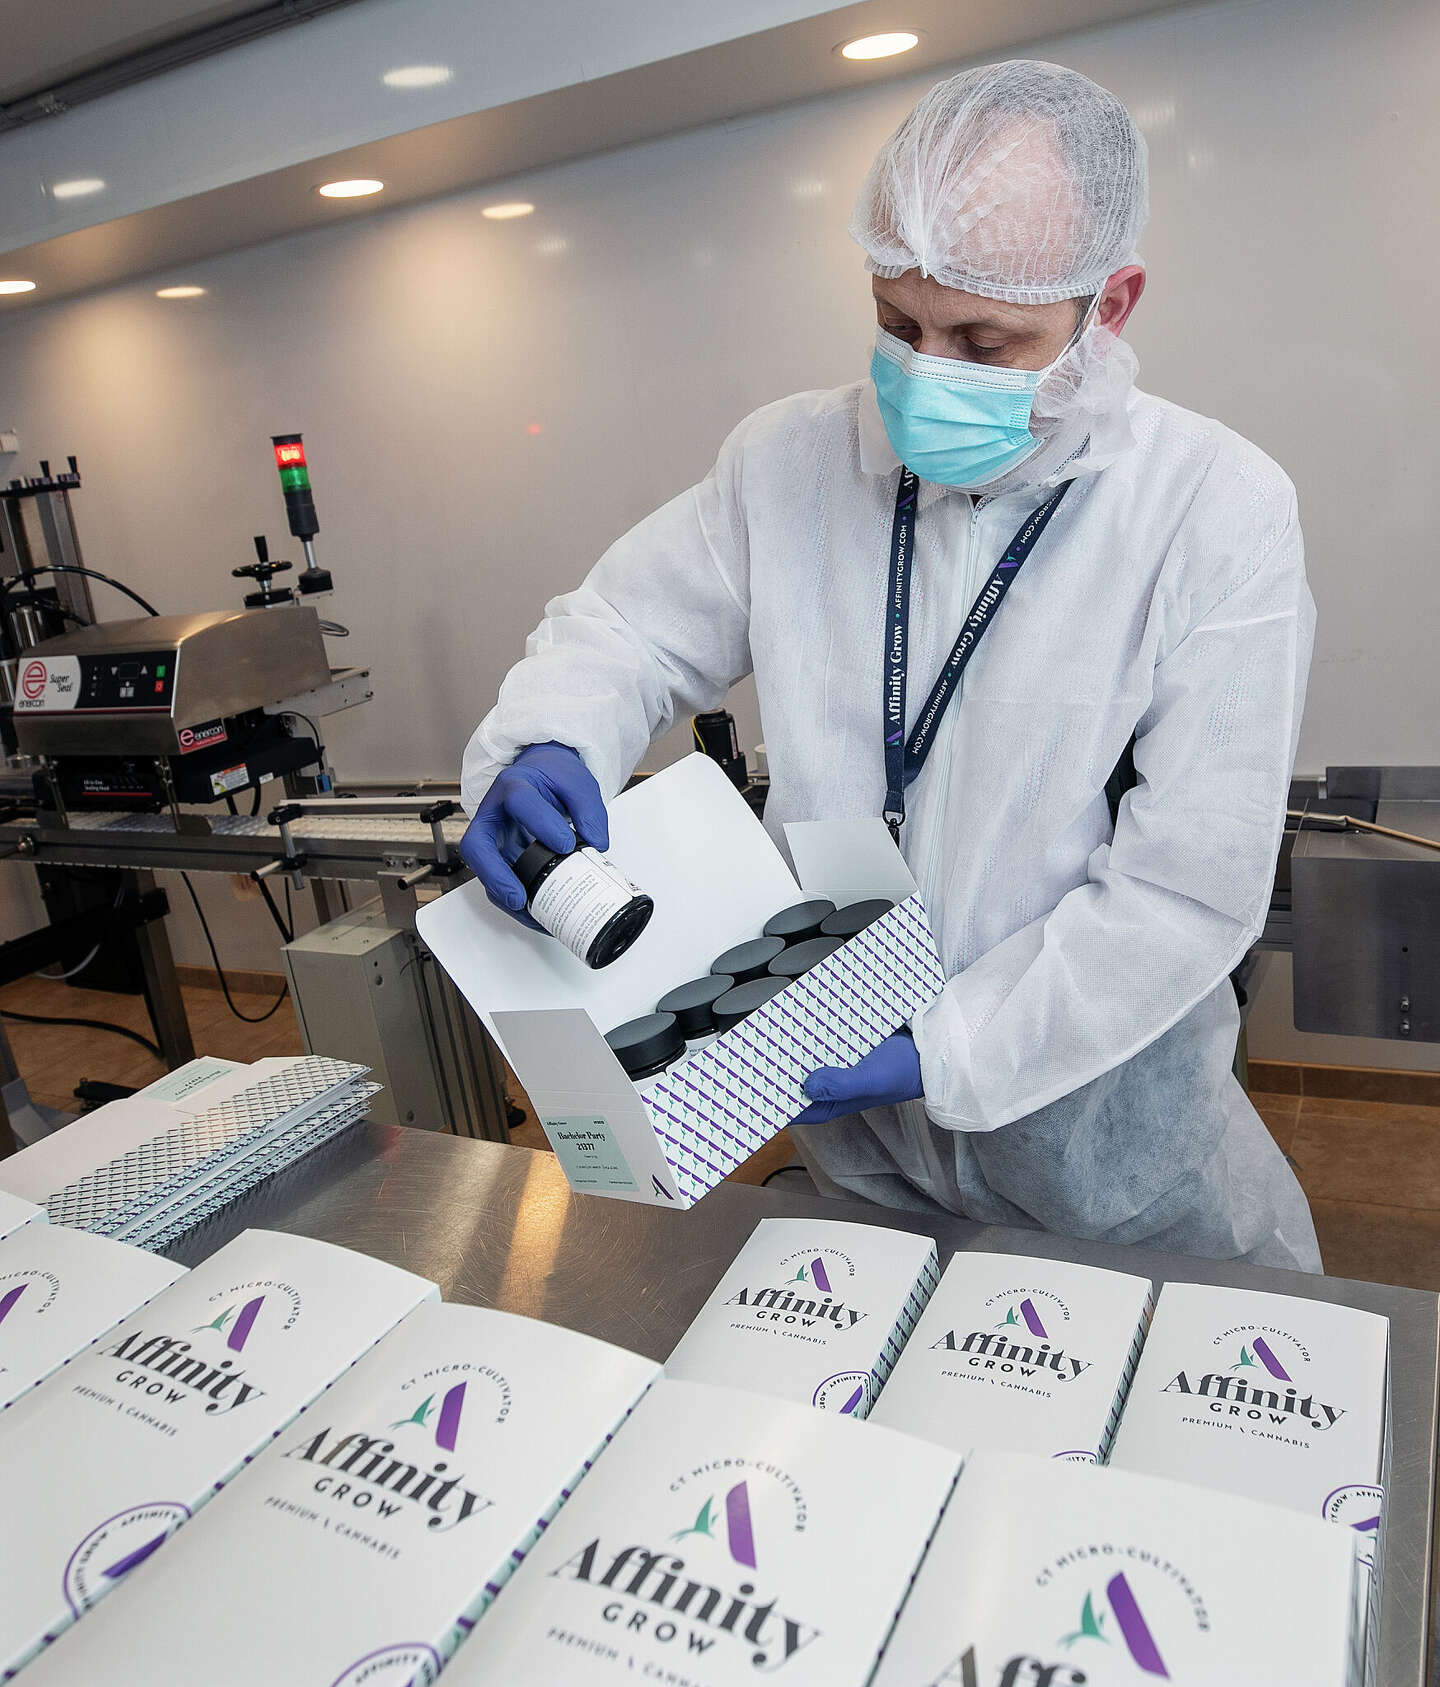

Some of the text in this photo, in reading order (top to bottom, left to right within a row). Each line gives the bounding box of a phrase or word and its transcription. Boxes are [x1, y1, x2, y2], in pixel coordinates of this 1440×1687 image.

[896, 525, 908, 609] AFFINITYGROW.COM
[951, 573, 1005, 669] Affinity Grow
[50, 674, 70, 684] Super
[57, 684, 73, 693] Seal
[889, 624, 905, 725] Affinity Grow
[912, 679, 949, 755] AFFINITYGROW.COM
[557, 1131, 606, 1142] Bachelor Party
[791, 1248, 855, 1276] MICRO-CULTIVATOR
[230, 1280, 302, 1331] MICRO-CULTIVATOR
[721, 1287, 870, 1331] Affinity
[756, 1310, 817, 1328] GROW
[996, 1287, 1070, 1321] MICRO-CULTIVATOR
[730, 1322, 828, 1346] PREMIUM CANNABIS
[929, 1330, 1094, 1382] Affinity
[1223, 1325, 1311, 1362] MICRO-CULTIVATOR
[96, 1330, 268, 1416] Affinity
[116, 1370, 188, 1404] GROW
[941, 1370, 1052, 1398] PREMIUM CANNABIS
[968, 1357, 1037, 1377] GROW
[72, 1384, 178, 1438] PREMIUM CANNABIS
[401, 1363, 512, 1424] CT MICRO-CULTIVATOR
[1160, 1370, 1349, 1430] Affinity
[1209, 1402, 1288, 1425] GROW
[1182, 1416, 1311, 1449] PREMIUM CANNABIS
[279, 1426, 496, 1533] Affinity
[314, 1477, 404, 1519] GROW
[670, 1458, 807, 1533] CT MICRO-CULTIVATOR
[265, 1496, 402, 1560] PREMIUM CANNABIS
[549, 1537, 821, 1673] Affinity
[1056, 1544, 1210, 1632] MICRO-CULTIVATOR
[547, 1627, 619, 1660] PREMIUM
[602, 1602, 716, 1656] GROW
